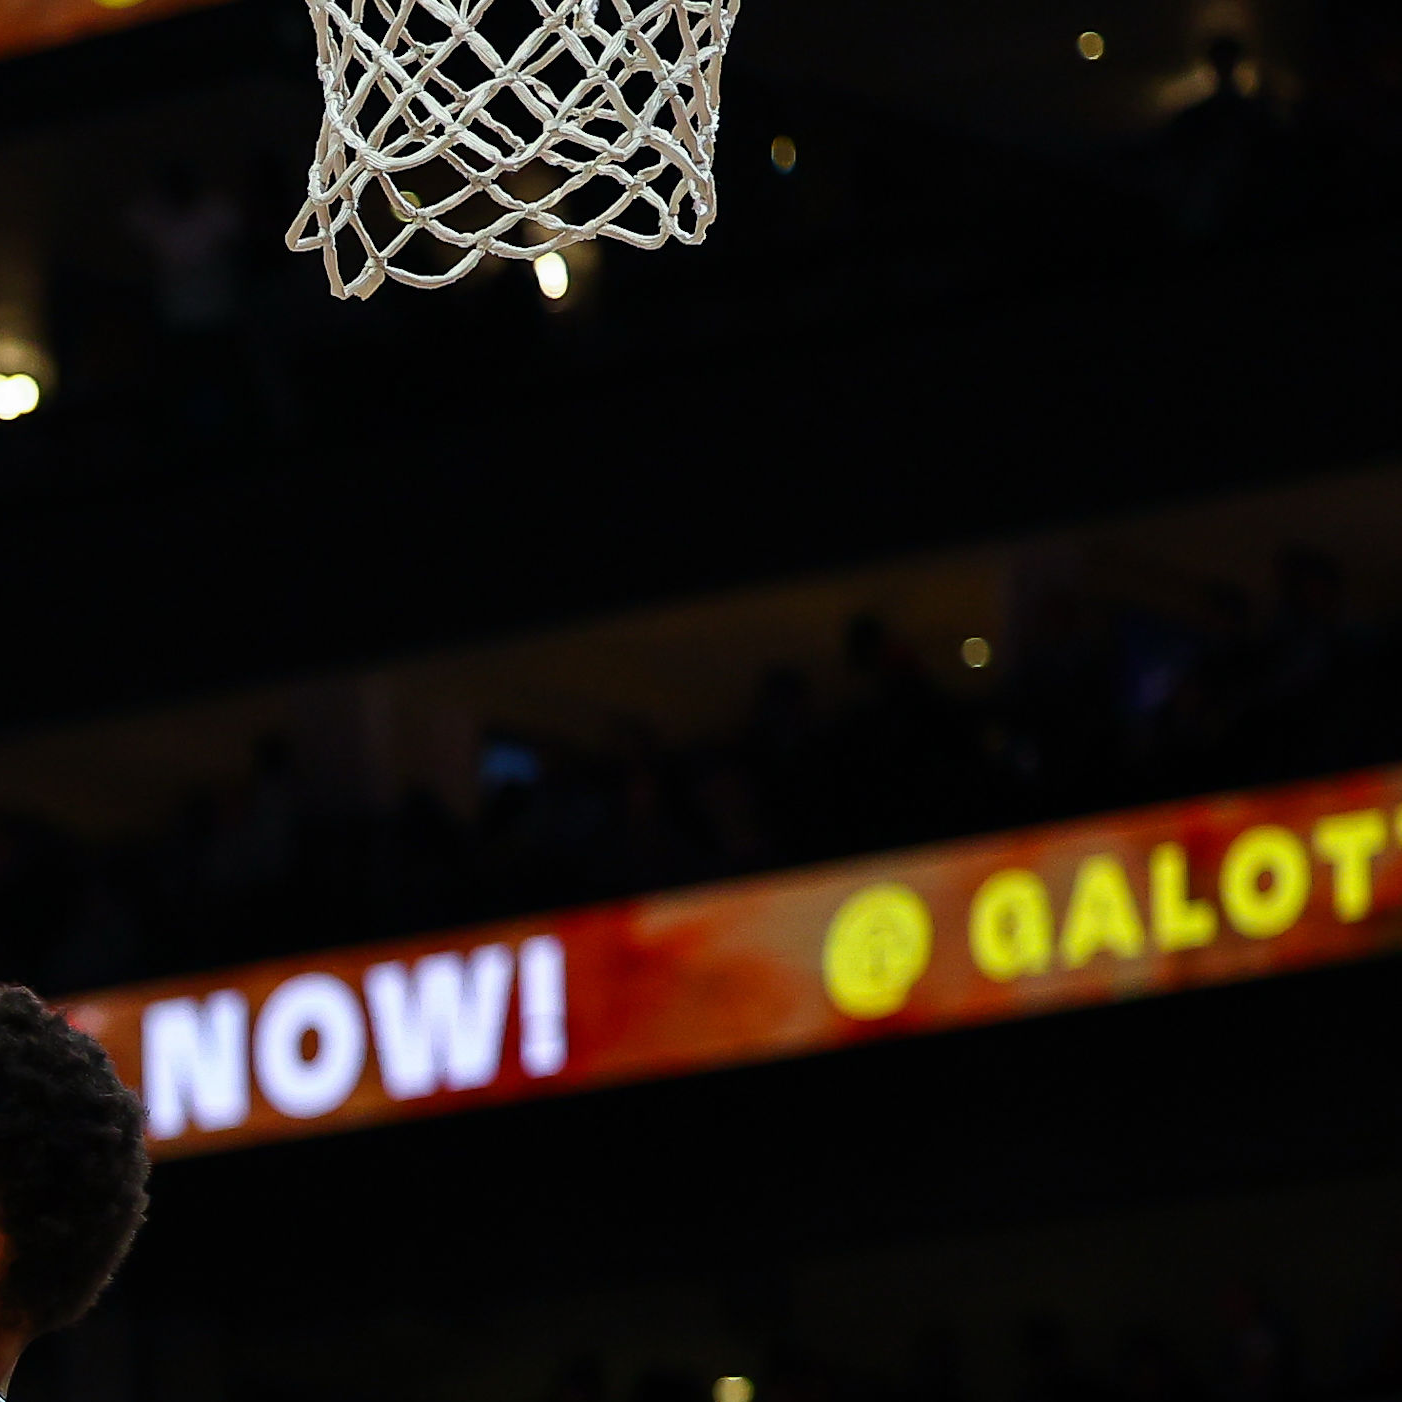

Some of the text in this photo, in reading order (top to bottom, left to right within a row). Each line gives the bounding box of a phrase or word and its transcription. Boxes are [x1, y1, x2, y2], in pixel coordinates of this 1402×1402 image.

[141, 934, 568, 1139] NOW!
[821, 882, 935, 1021] @
[967, 808, 1402, 982] GALOT
